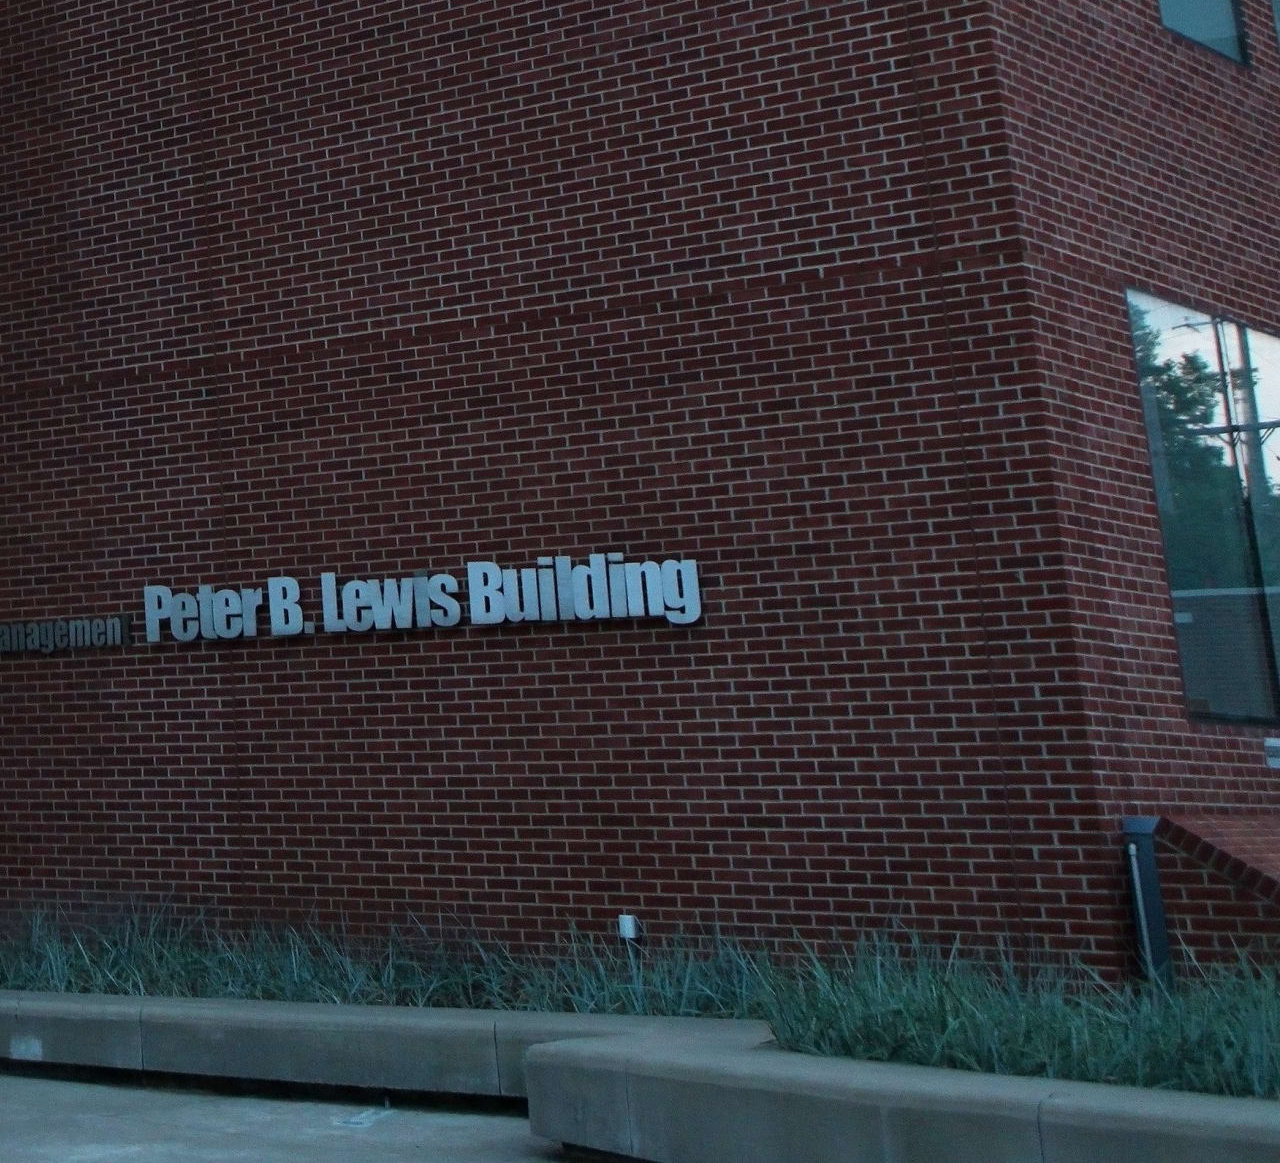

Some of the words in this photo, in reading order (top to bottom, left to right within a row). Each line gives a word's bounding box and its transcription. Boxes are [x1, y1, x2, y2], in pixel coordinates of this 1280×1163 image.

[144, 584, 262, 642] Peter
[267, 576, 315, 635] B.
[321, 572, 461, 633] Lewis
[467, 552, 702, 624] Building
